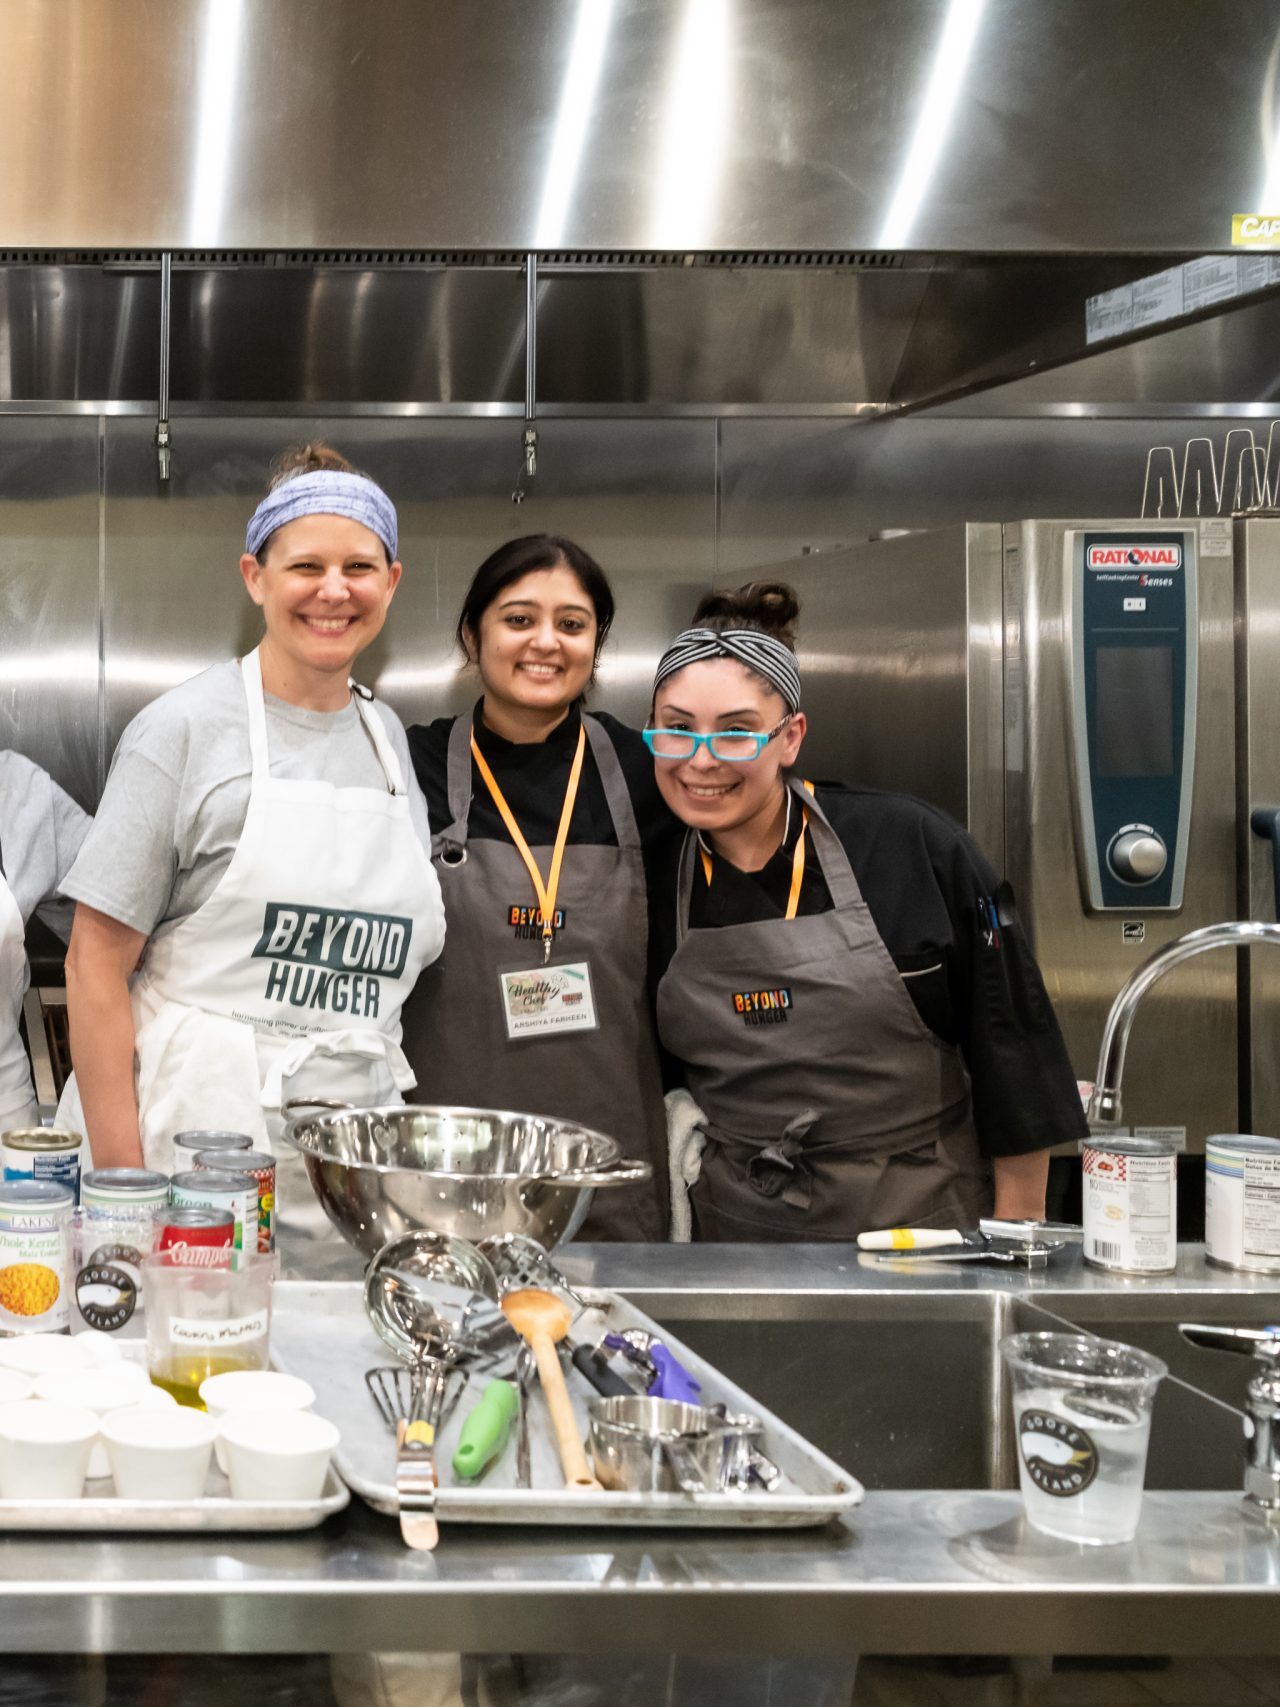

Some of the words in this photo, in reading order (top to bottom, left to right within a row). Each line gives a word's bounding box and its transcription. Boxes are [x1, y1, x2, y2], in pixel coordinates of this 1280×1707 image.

[1092, 548, 1177, 565] RATIONAL
[511, 907, 563, 928] BEYOD
[266, 911, 405, 972] BEYOND
[265, 962, 380, 1019] HUNGER
[508, 981, 560, 1000] Healthy
[735, 989, 789, 1012] BEYOND
[743, 1009, 788, 1026] HUNGER
[84, 1269, 126, 1286] GOOSE
[86, 1306, 127, 1328] ISLAND
[1026, 1415, 1079, 1442] GOOSE
[1029, 1462, 1082, 1490] ISLAND
